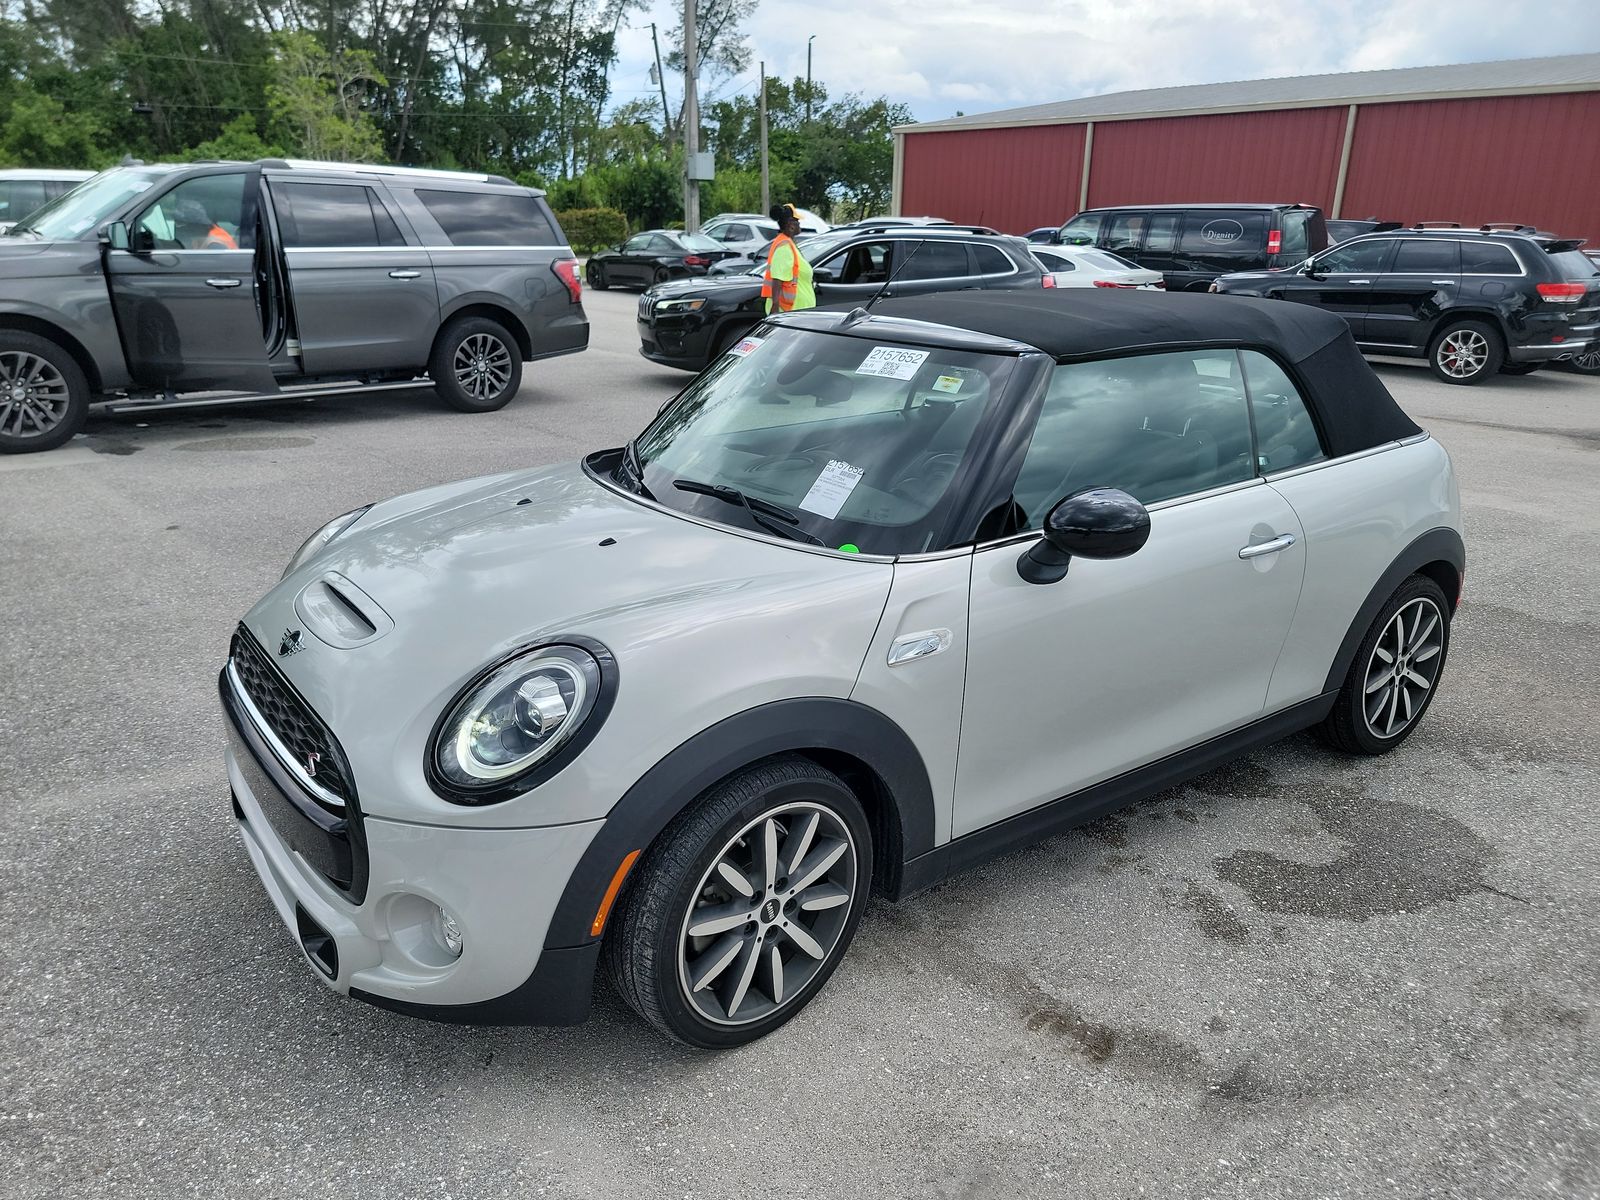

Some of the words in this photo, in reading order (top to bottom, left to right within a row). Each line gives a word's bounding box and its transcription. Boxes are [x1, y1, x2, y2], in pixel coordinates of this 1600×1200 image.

[1207, 230, 1237, 241] Dignity
[870, 349, 923, 364] 2157652
[766, 902, 775, 920] MINI
